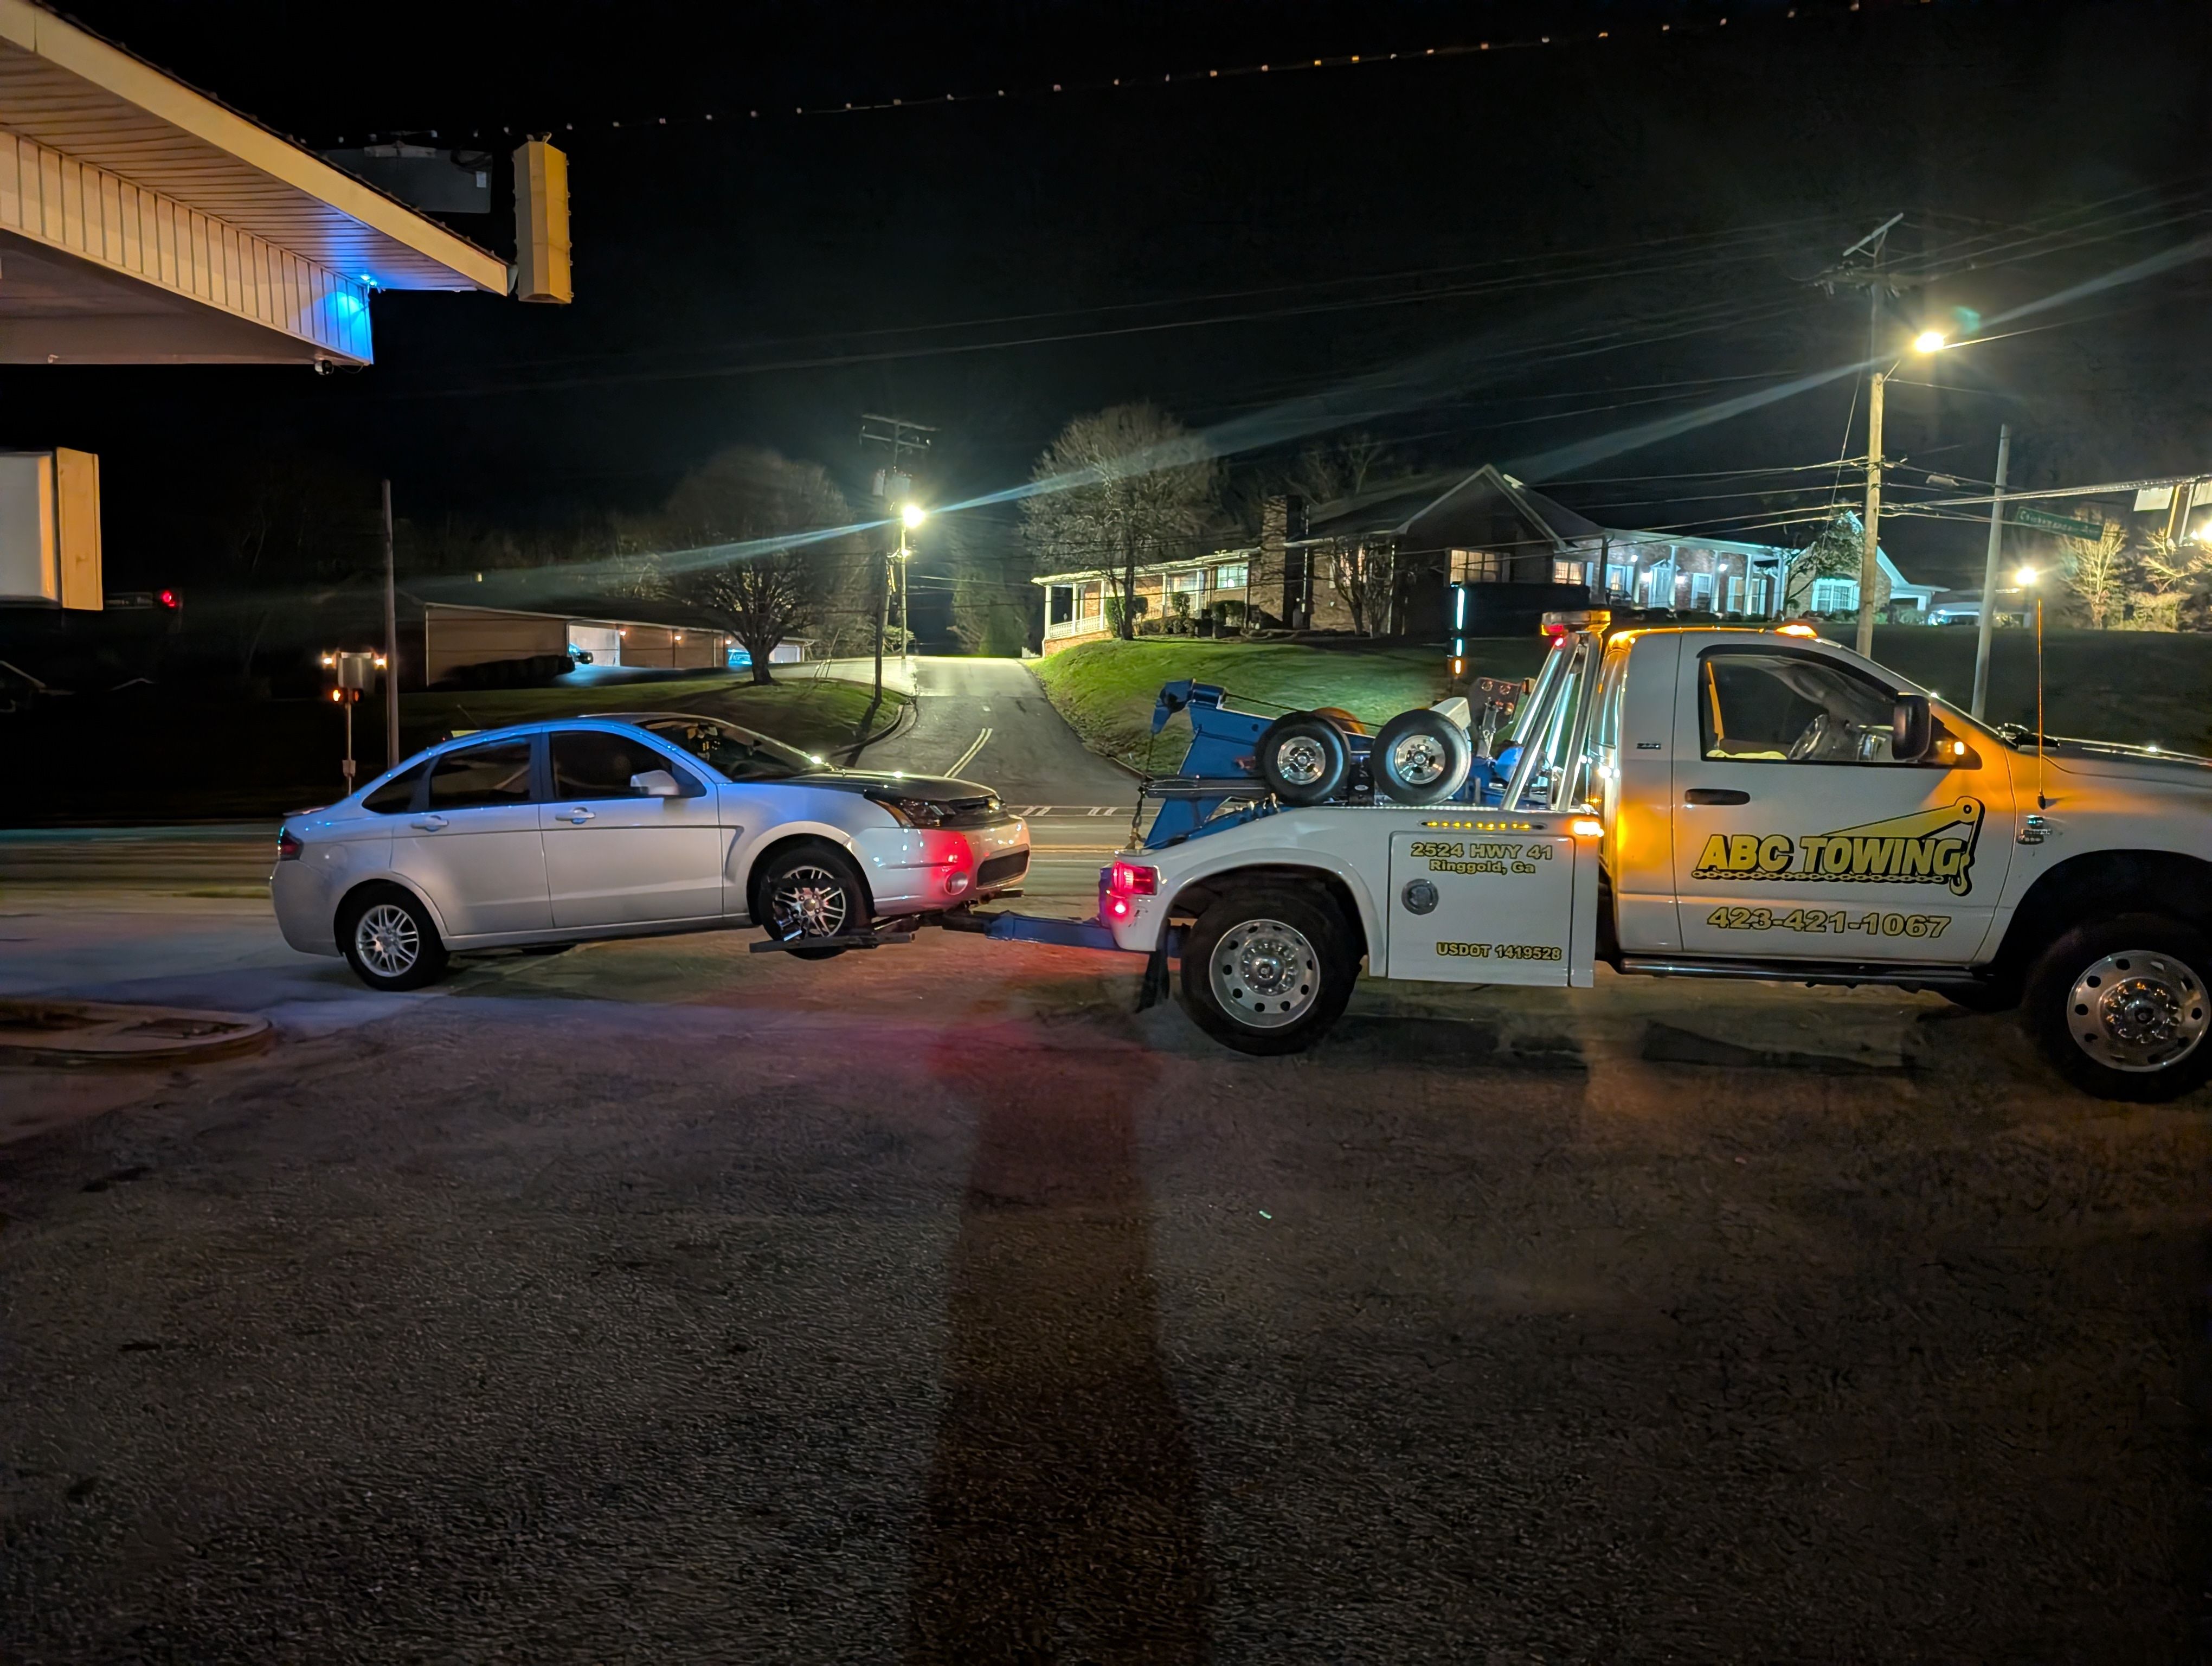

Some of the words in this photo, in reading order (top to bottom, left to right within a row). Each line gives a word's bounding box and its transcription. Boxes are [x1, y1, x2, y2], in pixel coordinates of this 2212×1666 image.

[1411, 842, 1463, 858] 2524
[1469, 844, 1522, 859] HWY
[1526, 844, 1553, 860] 41
[1695, 834, 1794, 873] ABC
[1799, 835, 1965, 876] TOWING
[1429, 858, 1508, 875] Ringgold,
[1511, 861, 1536, 874] Ga
[1706, 906, 1951, 939] 423-421-1067
[1436, 942, 1492, 958] USDOT
[1495, 944, 1562, 961] 1419528
